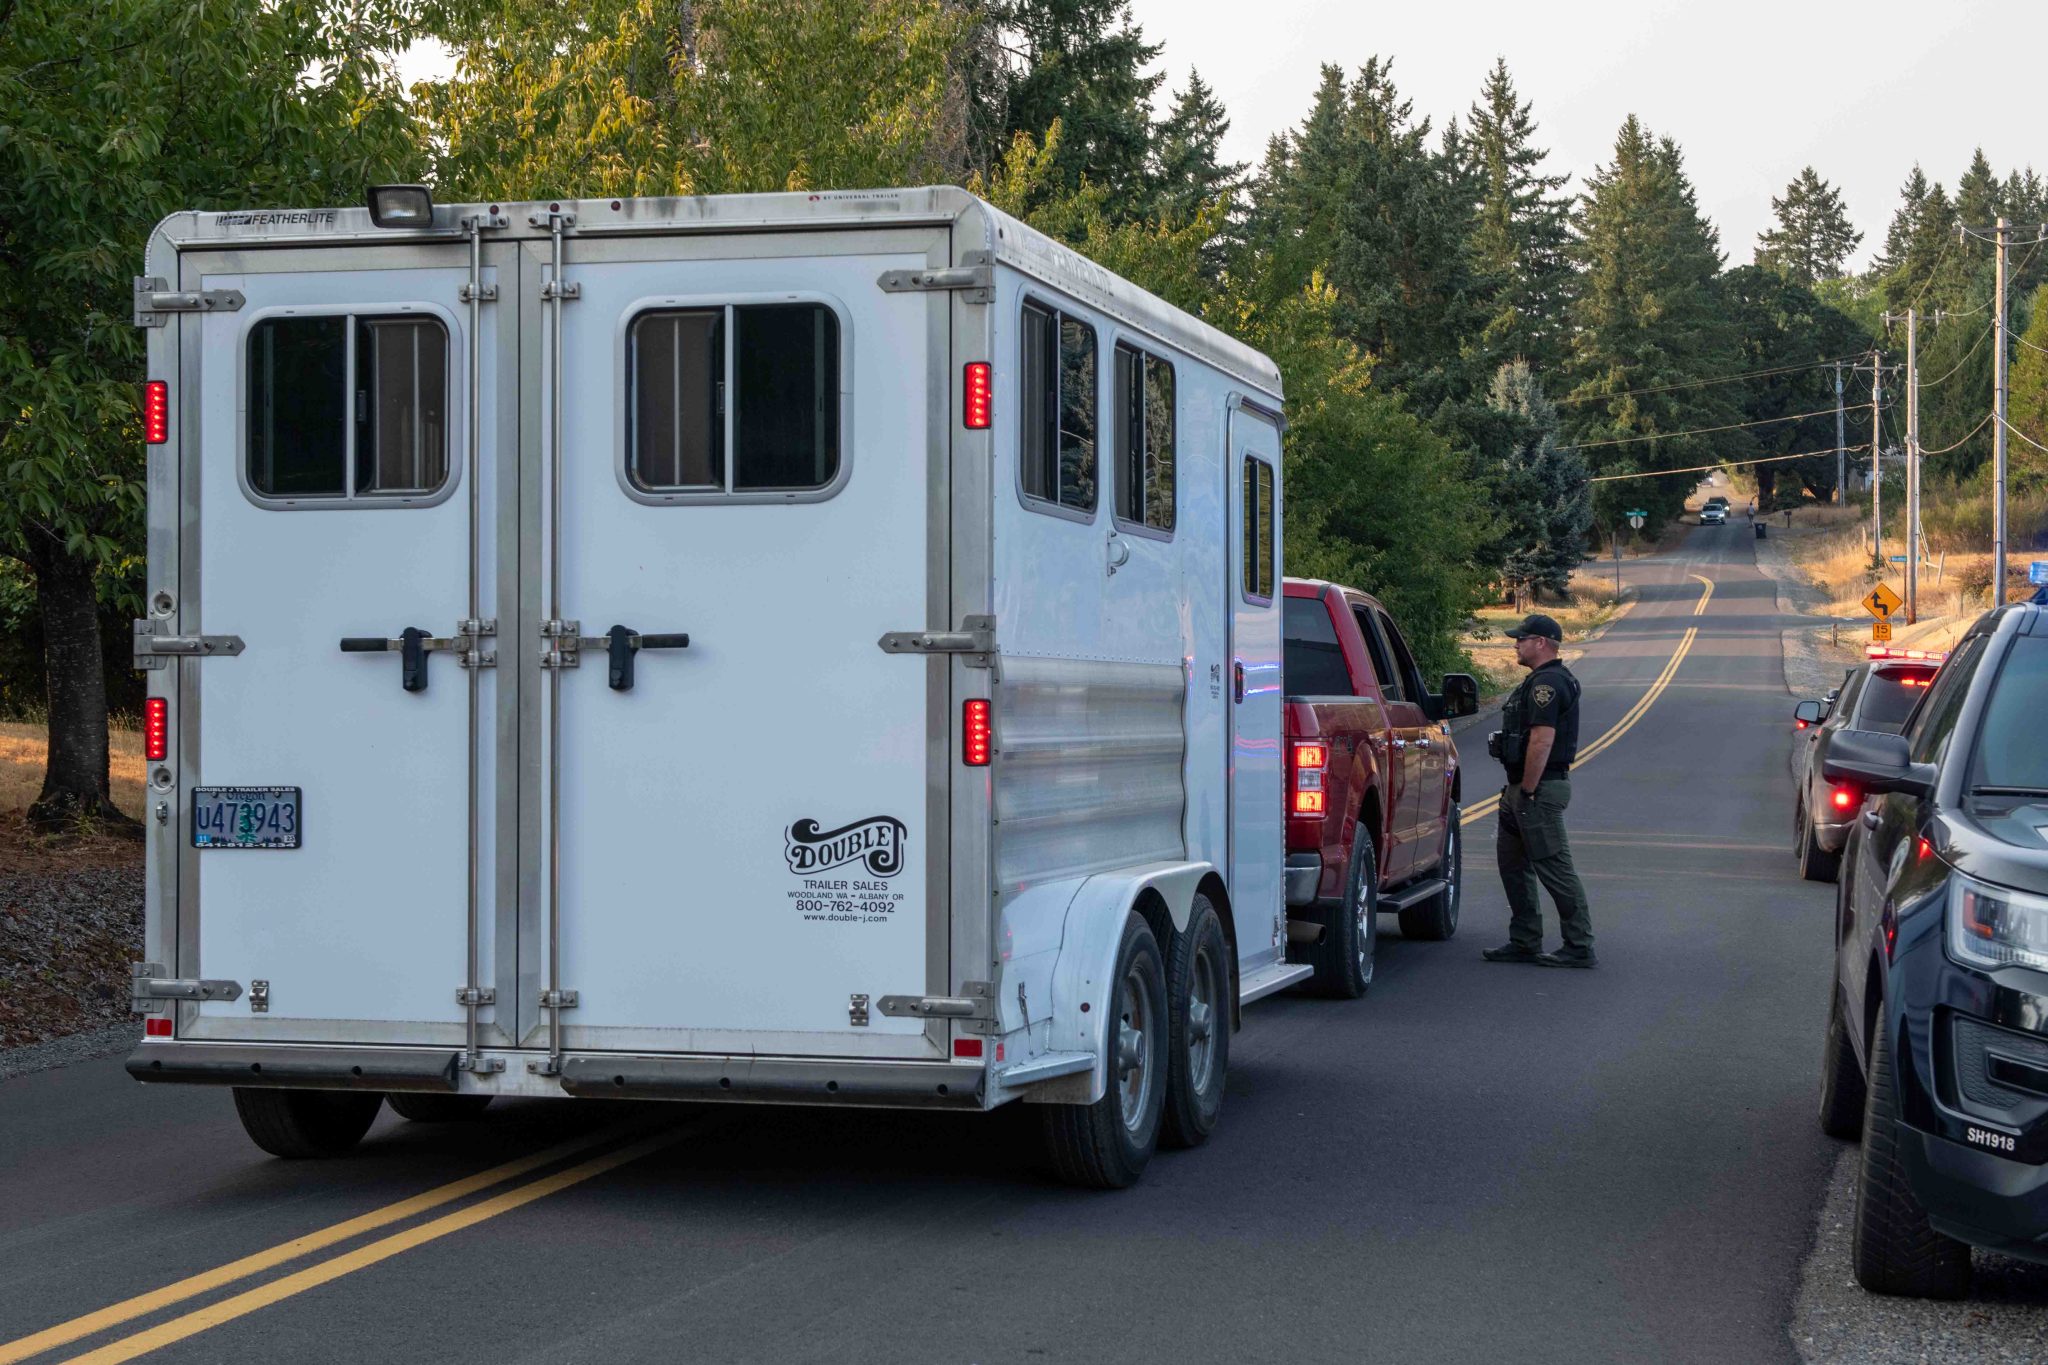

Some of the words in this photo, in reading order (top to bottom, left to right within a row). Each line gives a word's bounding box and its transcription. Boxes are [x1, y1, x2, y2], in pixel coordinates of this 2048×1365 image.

[251, 212, 334, 225] FEATHERLITE
[1876, 625, 1888, 634] 15
[226, 792, 266, 802] Oregon
[197, 803, 295, 833] U473943
[791, 825, 891, 869] DOUBLE
[803, 880, 848, 890] TRAILER
[853, 881, 888, 891] SALES
[787, 891, 833, 899] WOODLAND
[796, 900, 895, 913] 800-762-4092
[804, 913, 888, 923] www.double-j.com
[1967, 1127, 2015, 1151] SH1918
